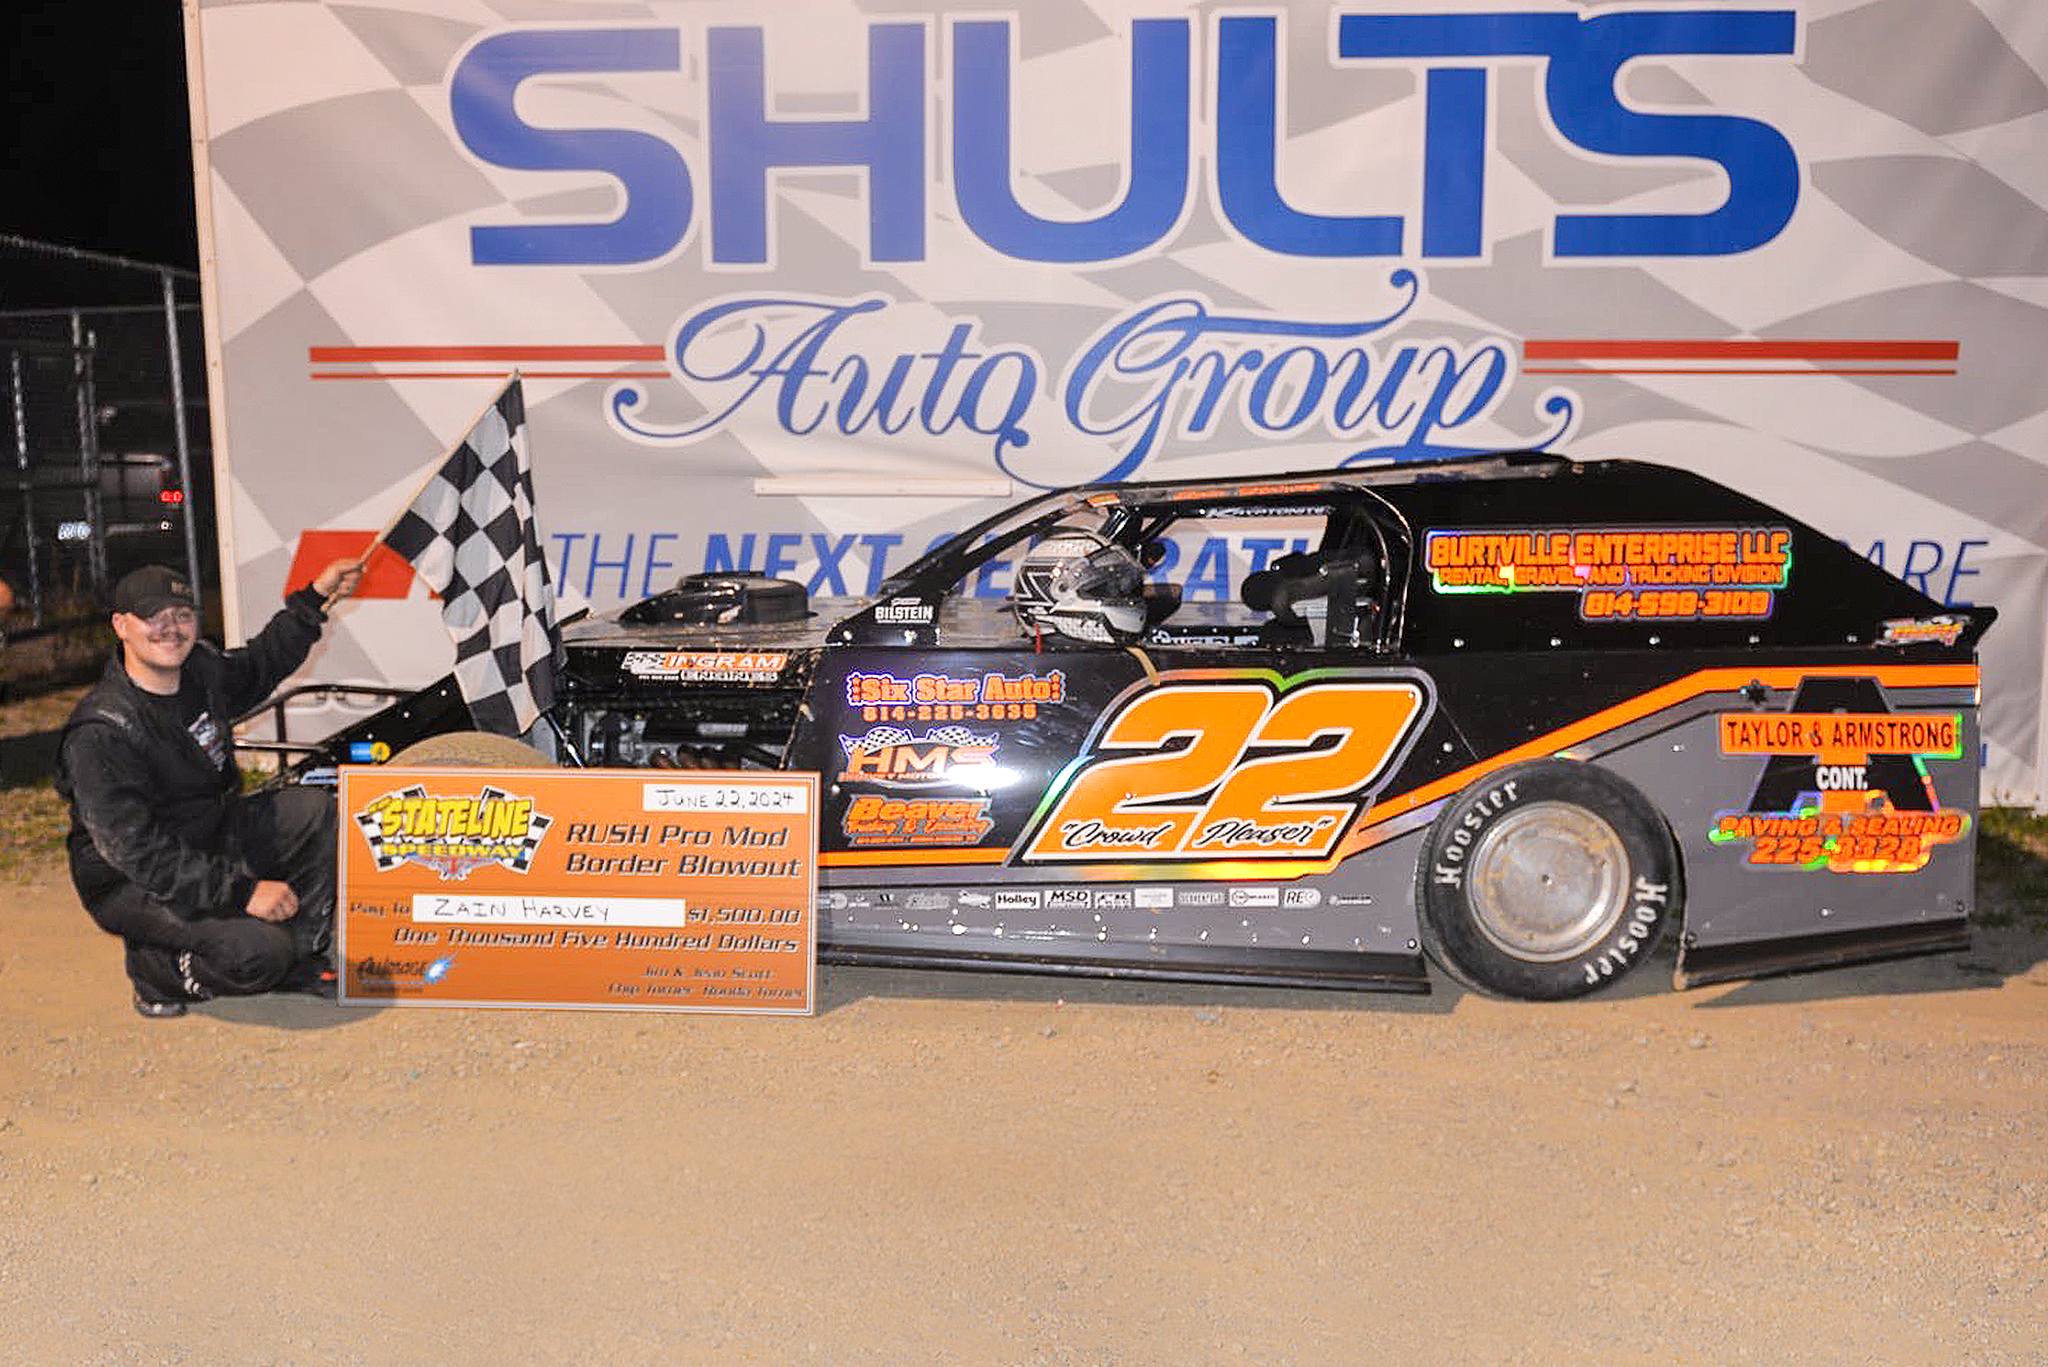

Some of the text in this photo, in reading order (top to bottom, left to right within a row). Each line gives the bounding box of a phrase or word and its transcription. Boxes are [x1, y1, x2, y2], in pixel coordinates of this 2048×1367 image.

[450, 10, 1800, 266] SHULTS
[613, 269, 1573, 490] Auto Group
[1430, 532, 1788, 567] BURTVILLE ENTERPRISE LLC
[552, 532, 678, 599] THE
[704, 533, 904, 599] NEXT
[1590, 565, 1626, 584] AND
[1713, 563, 1782, 583] DIVISION
[875, 605, 934, 620] BILSTEIN
[669, 654, 778, 670] INGRAM
[862, 677, 909, 701] Six
[916, 677, 978, 701] Star
[1727, 721, 1803, 748] TAYLOR
[1832, 721, 1953, 749] ARMSTRONG
[850, 745, 996, 775] HMS
[1022, 684, 1423, 861] 22
[1816, 766, 1868, 790] CONT.
[368, 797, 533, 839] STATELINE
[1719, 815, 1819, 837] PAVING
[566, 821, 790, 850] RUSH Pro Mod
[1434, 780, 1518, 890] Hoosier
[382, 842, 524, 857] SPEEDWAY
[566, 852, 802, 879] Border Blowout
[997, 894, 1037, 907] Holley
[1050, 890, 1088, 901] MSD
[688, 906, 802, 927] $1,500.00
[1583, 873, 1669, 986] Hoosier
[394, 927, 800, 953] One Thousand Five Hundred Dollars
